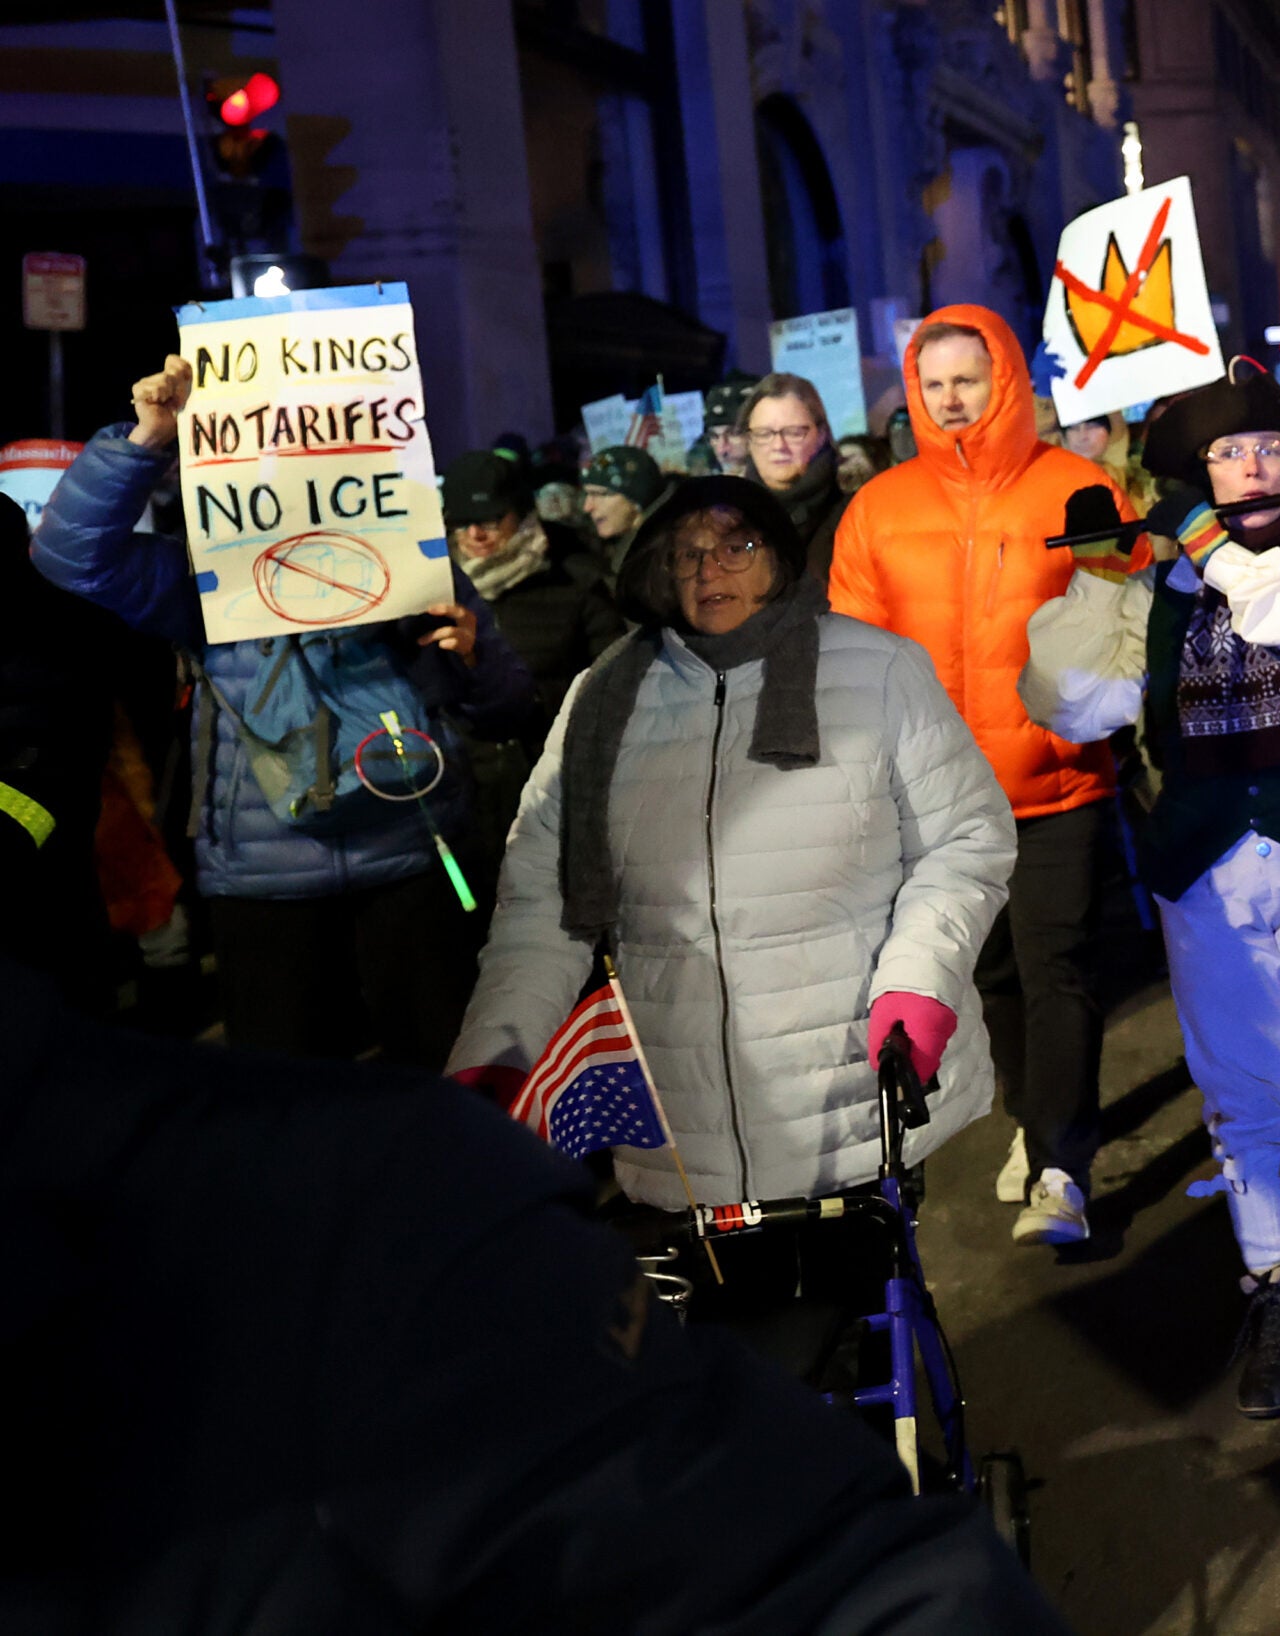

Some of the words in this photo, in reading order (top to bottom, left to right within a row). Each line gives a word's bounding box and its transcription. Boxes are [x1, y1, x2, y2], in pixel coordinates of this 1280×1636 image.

[196, 342, 258, 388] NO
[281, 333, 411, 375] KINGS
[191, 411, 240, 457] NO
[244, 397, 417, 450] TARIFFS
[197, 483, 283, 538] NO
[306, 472, 408, 525] ICE
